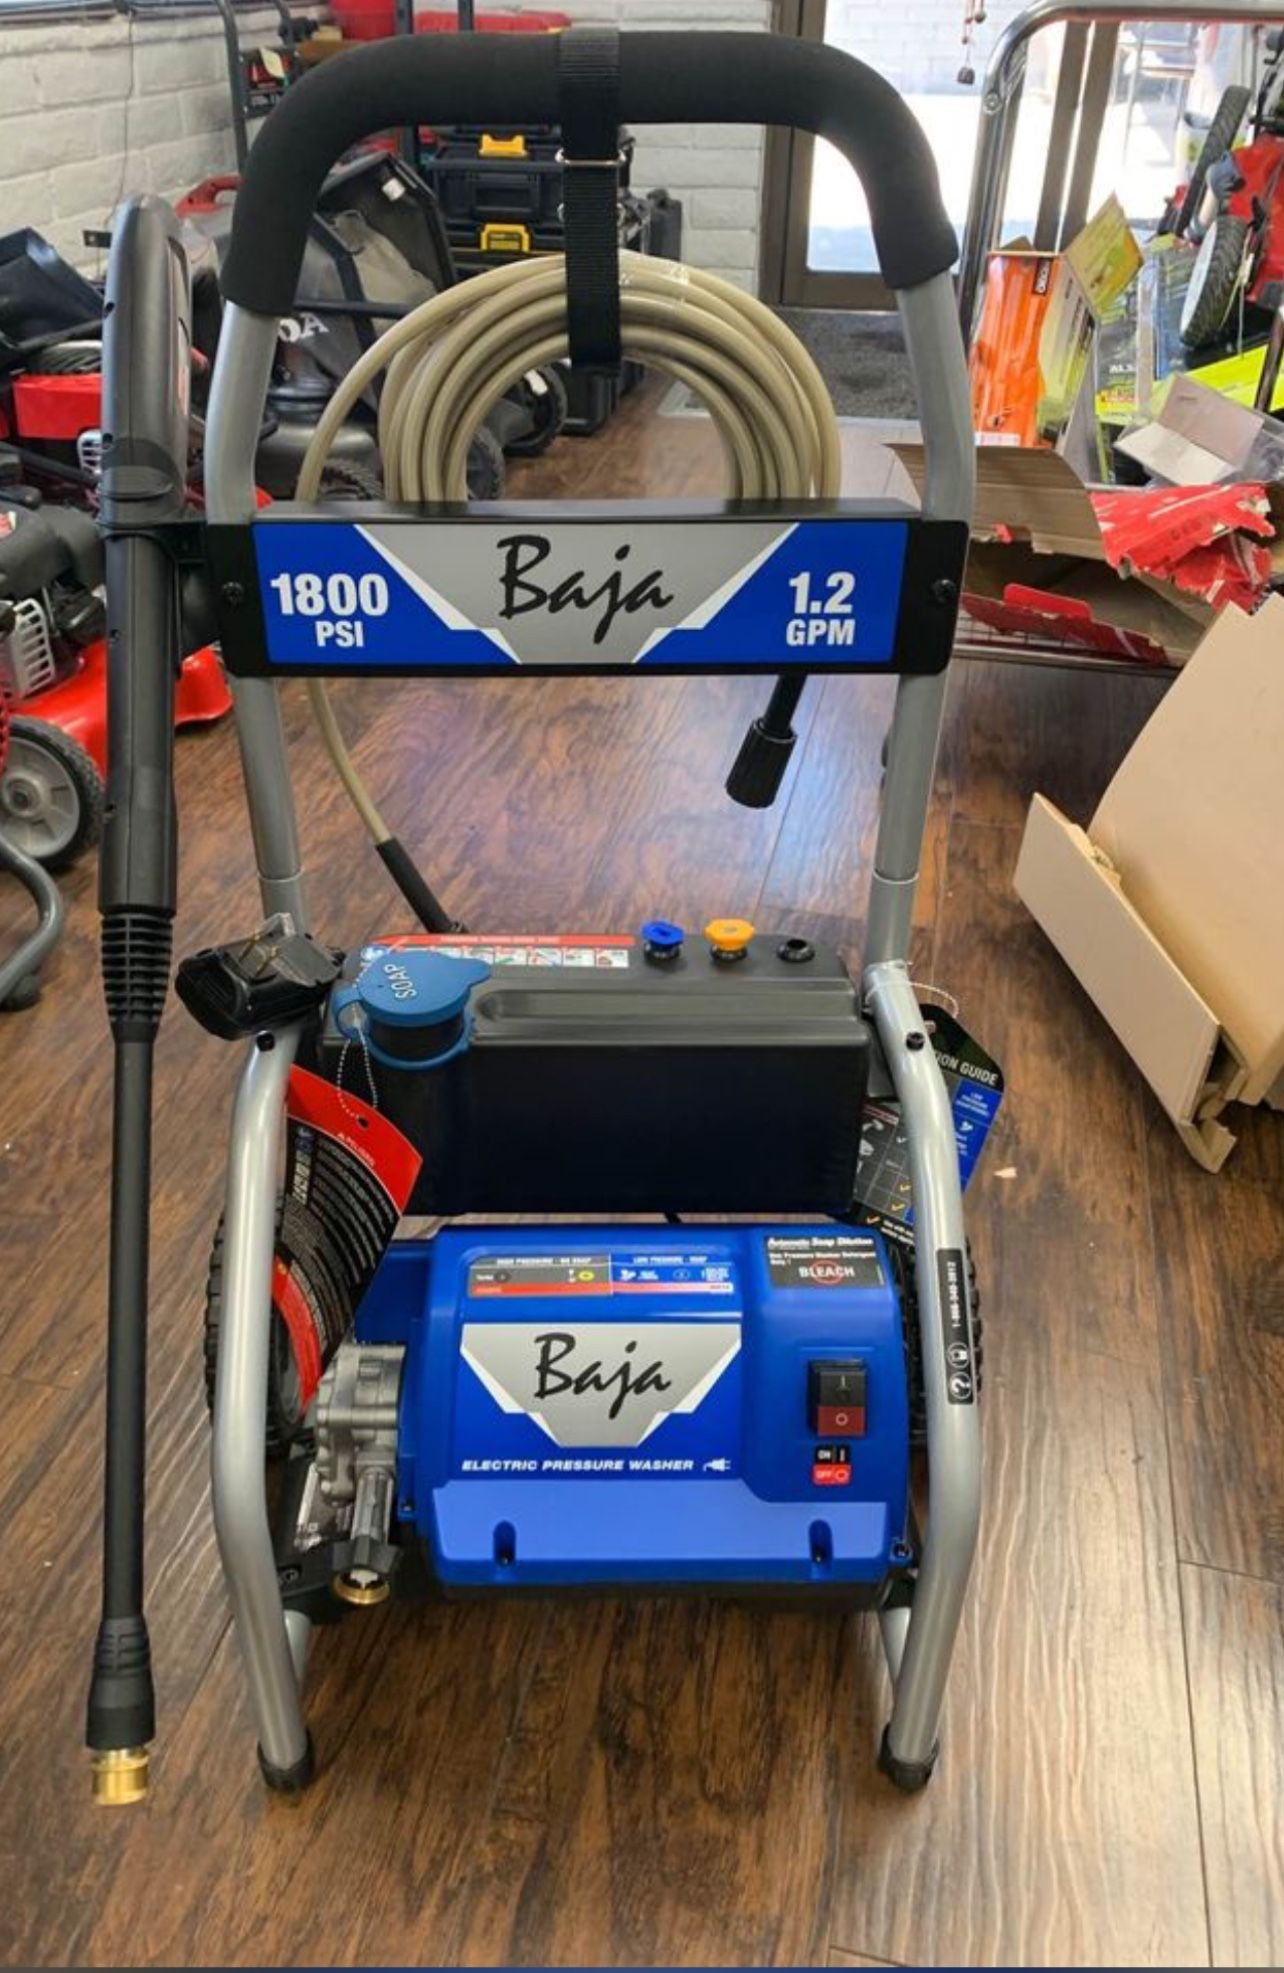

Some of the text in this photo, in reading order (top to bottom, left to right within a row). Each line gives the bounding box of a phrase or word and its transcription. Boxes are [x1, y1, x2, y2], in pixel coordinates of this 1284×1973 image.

[270, 573, 389, 616] 1800
[497, 534, 675, 645] Baja
[788, 571, 856, 614] 1.2
[315, 620, 365, 647] PSI
[786, 618, 856, 647] GPM
[384, 963, 418, 1000] SOAP
[960, 1061, 999, 1086] GUIDE
[798, 1265, 856, 1279] BLEACH
[533, 1332, 672, 1420] Baja
[461, 1459, 694, 1472] ELECTRIC PRESSURE WASHER
